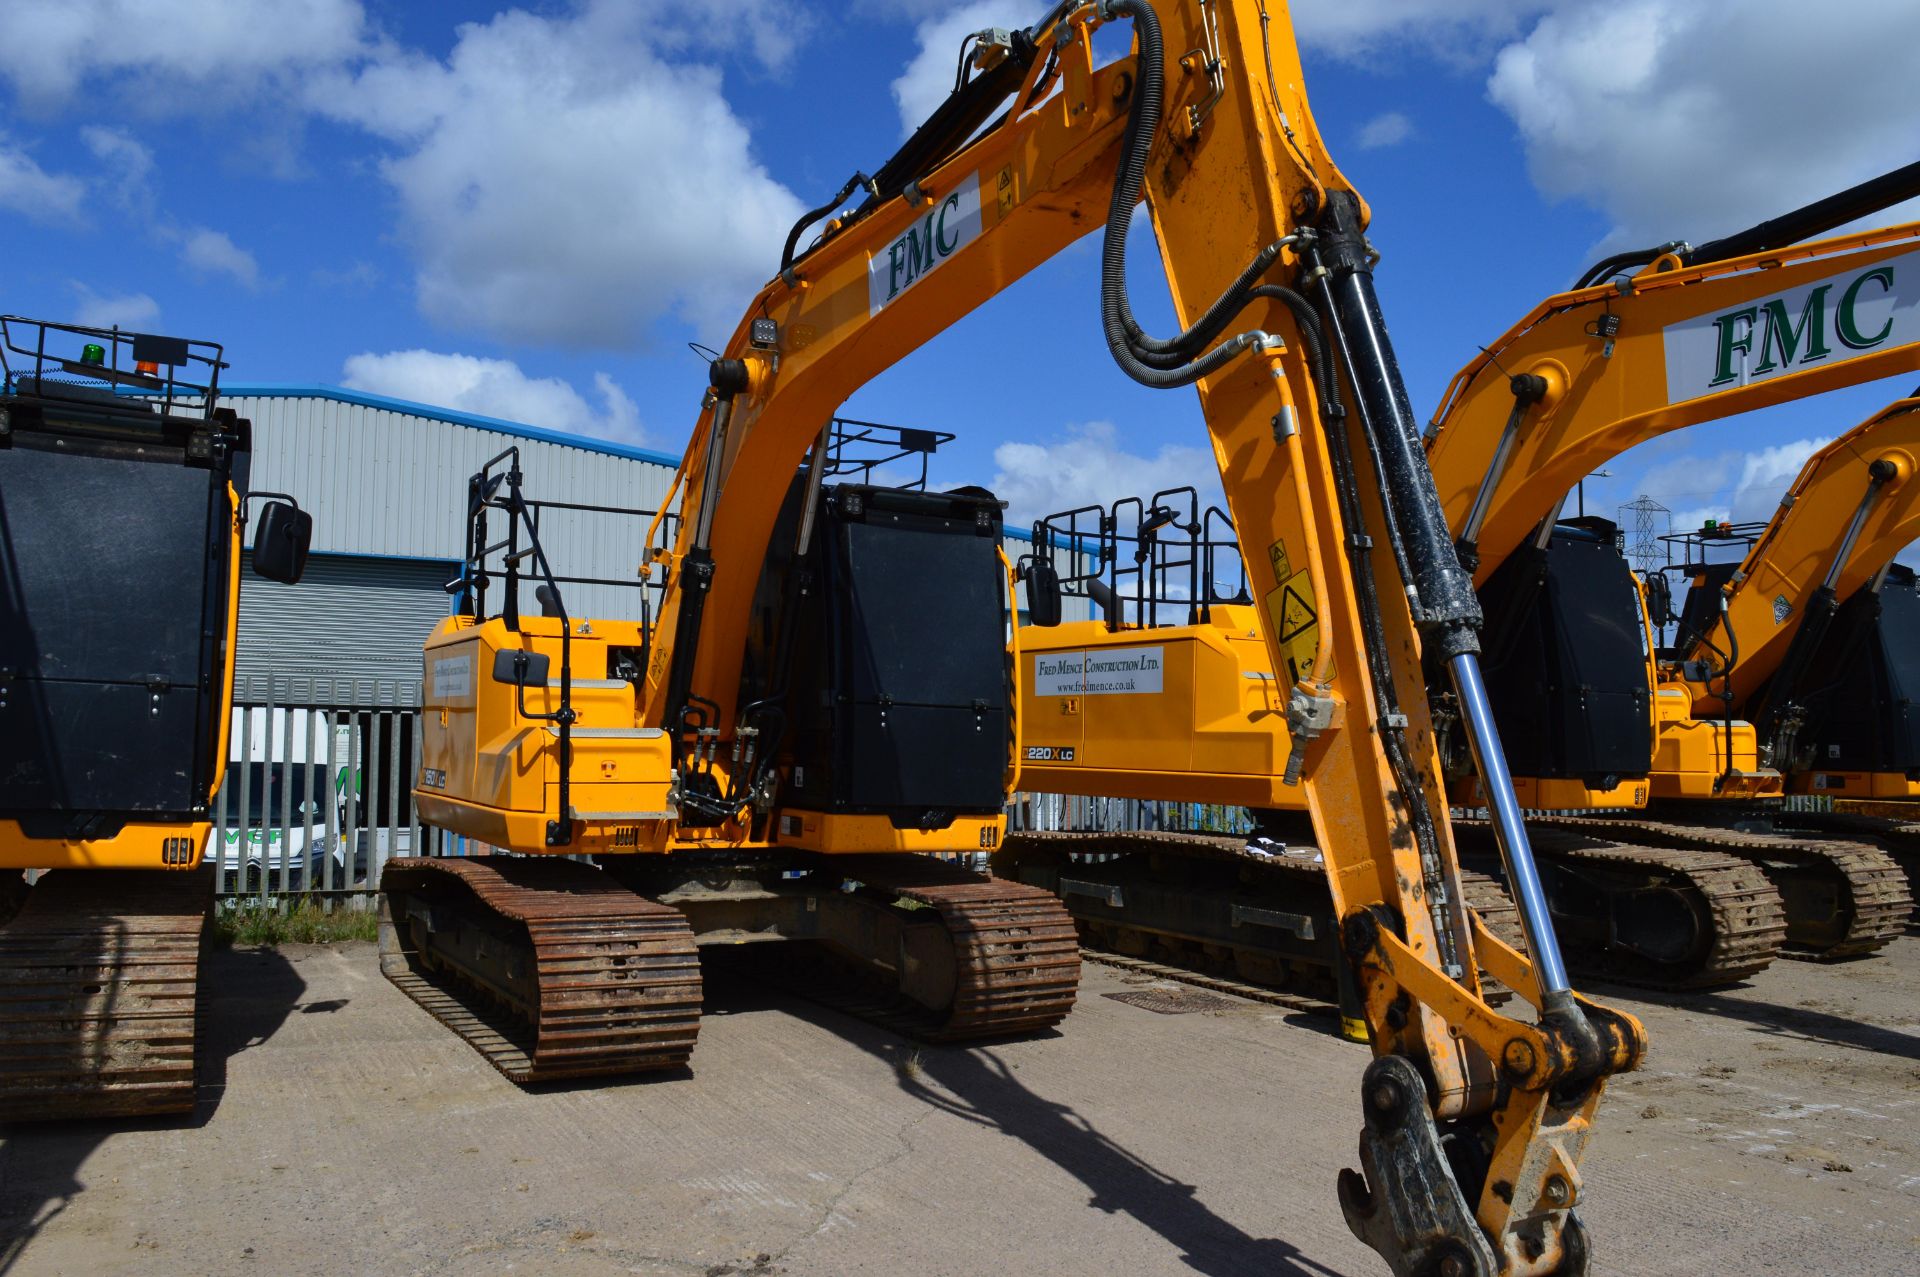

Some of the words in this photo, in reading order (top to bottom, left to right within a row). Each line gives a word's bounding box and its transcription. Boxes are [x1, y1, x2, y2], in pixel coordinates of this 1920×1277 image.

[887, 193, 959, 301] FMC
[1708, 266, 1894, 388] FMC
[1039, 661, 1056, 676] FRED
[1057, 679, 1136, 693] www.fredmence.co.uk
[1060, 751, 1073, 760] LC
